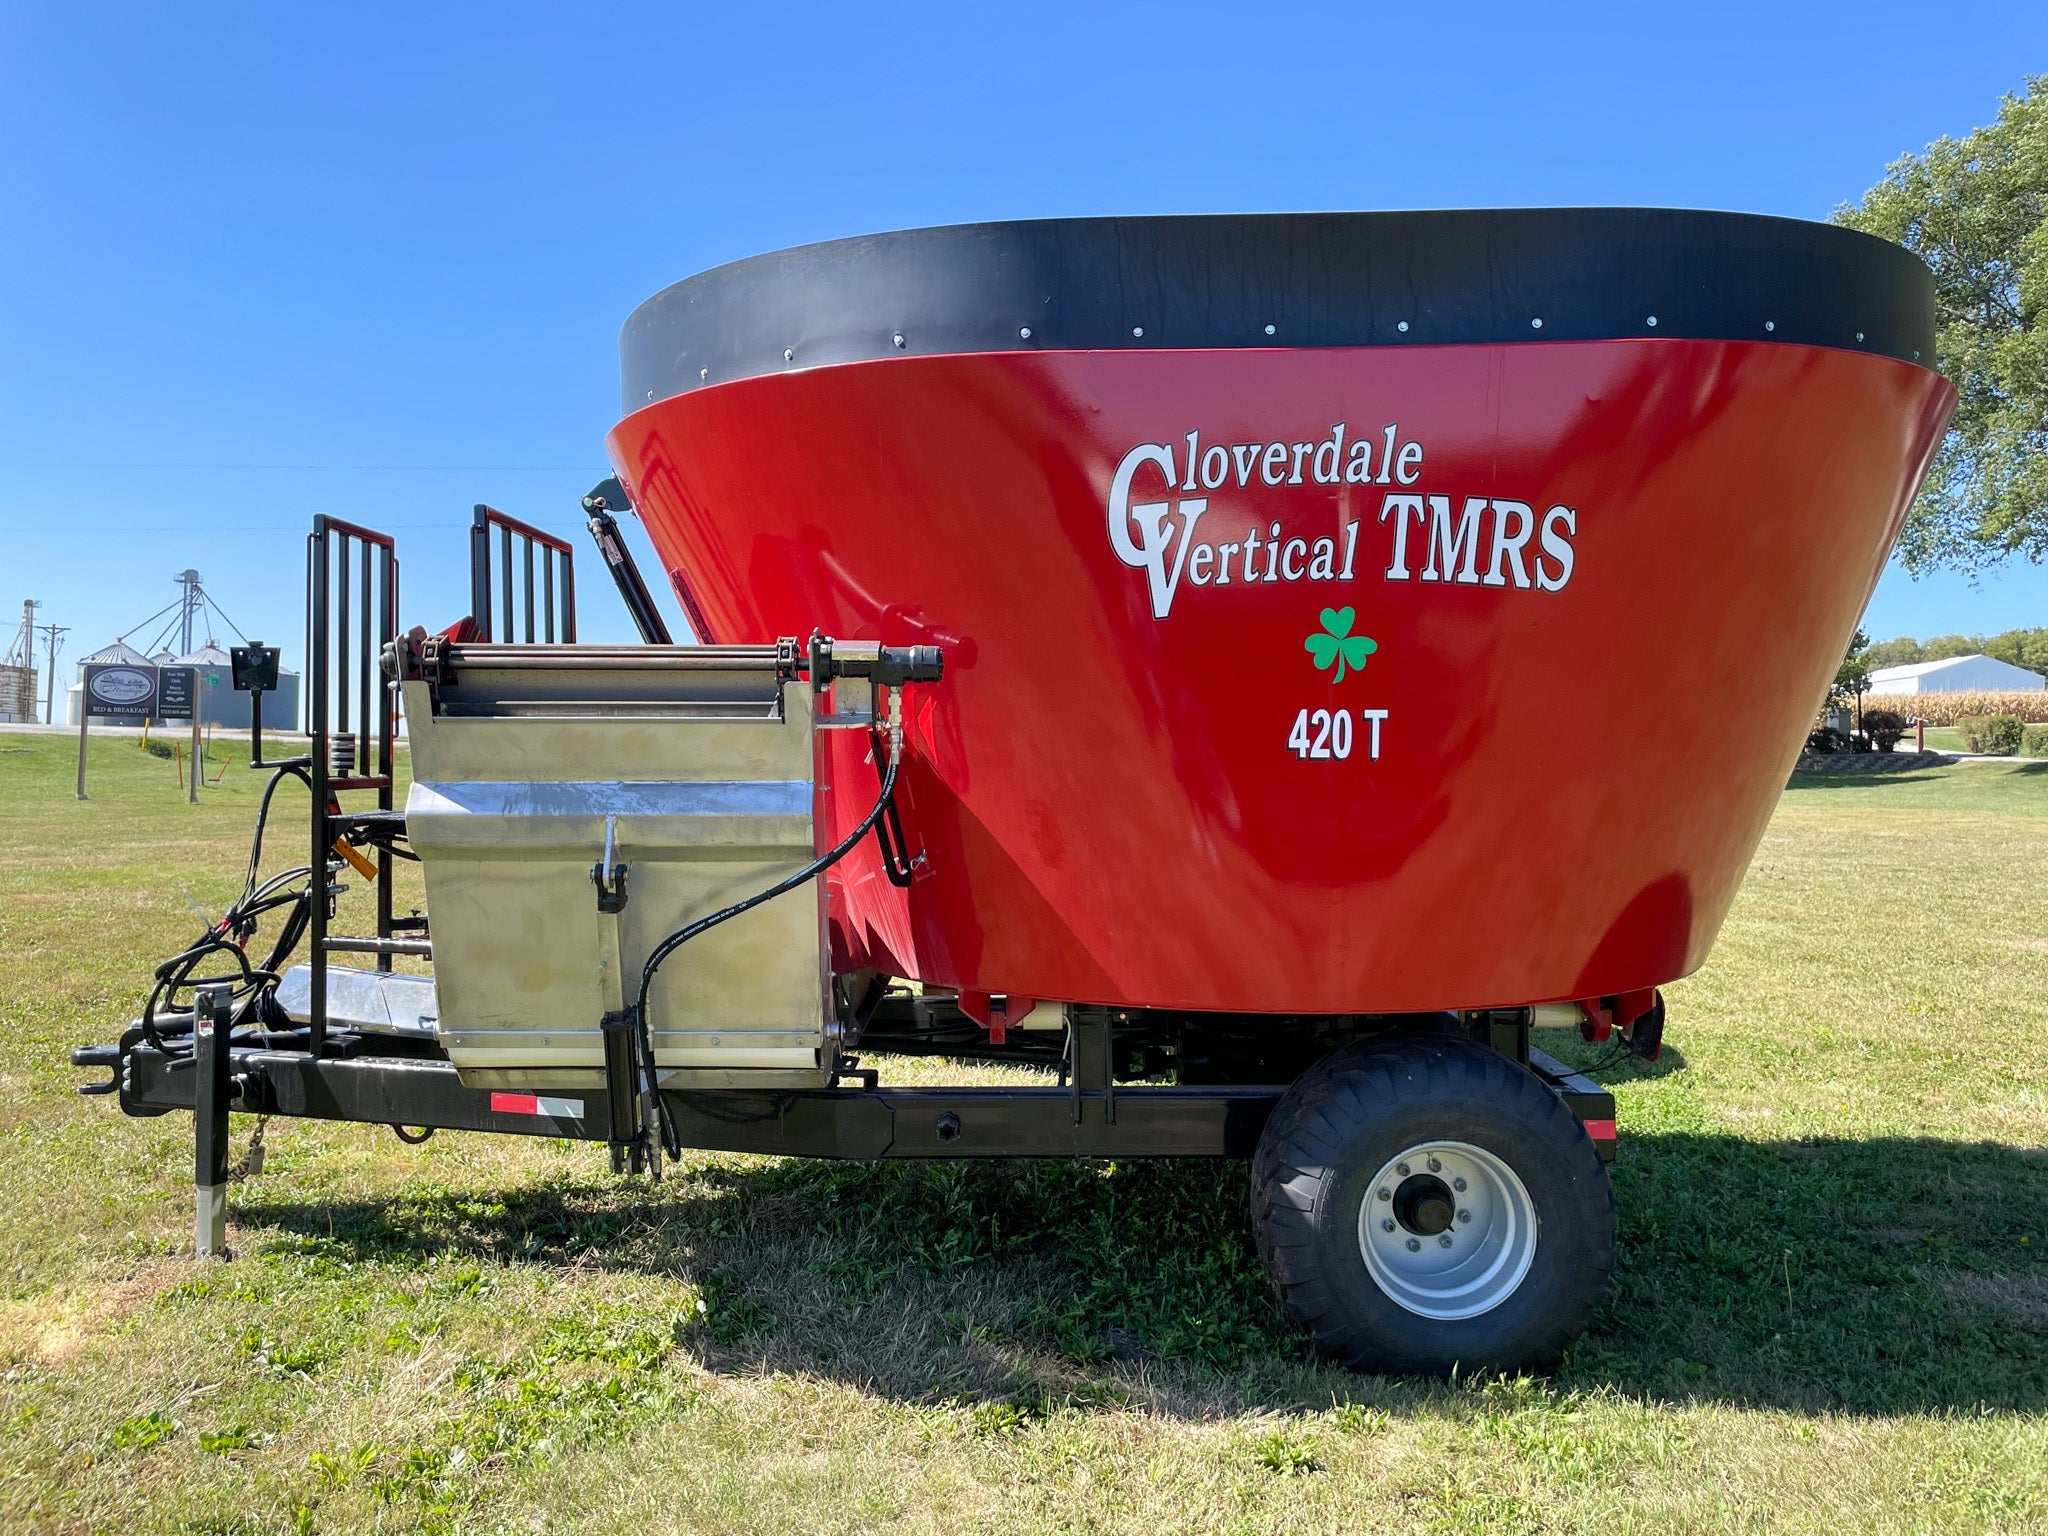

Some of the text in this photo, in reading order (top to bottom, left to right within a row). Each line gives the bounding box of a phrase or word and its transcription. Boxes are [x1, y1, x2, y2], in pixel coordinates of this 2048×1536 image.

[1107, 422, 1423, 567] Cloverdale
[1131, 492, 1578, 619] Vertical TMRS
[113, 706, 150, 714] BREAKFAST
[1287, 709, 1389, 762] 420 T
